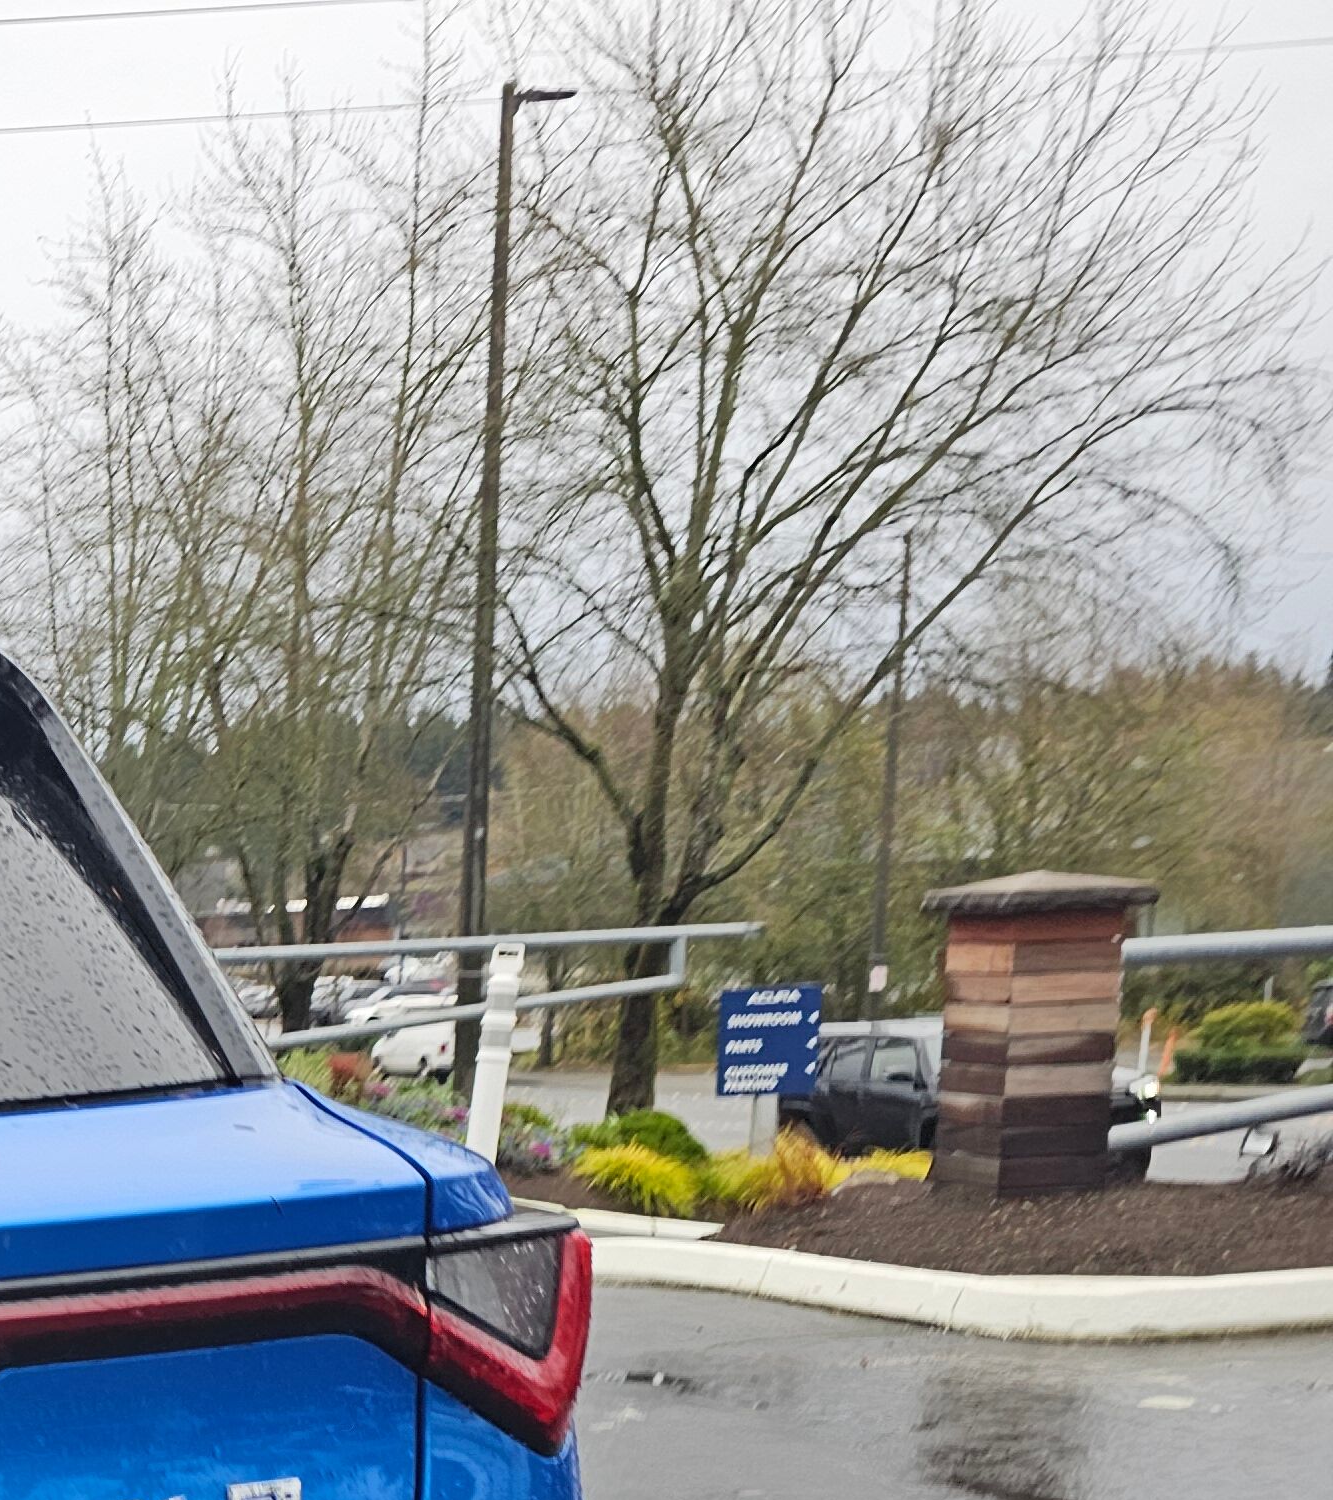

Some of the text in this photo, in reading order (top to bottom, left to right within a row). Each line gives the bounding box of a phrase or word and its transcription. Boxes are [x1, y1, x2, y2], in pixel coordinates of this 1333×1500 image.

[746, 988, 802, 1006] ACURA
[726, 1010, 803, 1030] SHOWROOM
[725, 1038, 764, 1055] PARTS
[724, 1062, 789, 1080] CUSTOMER
